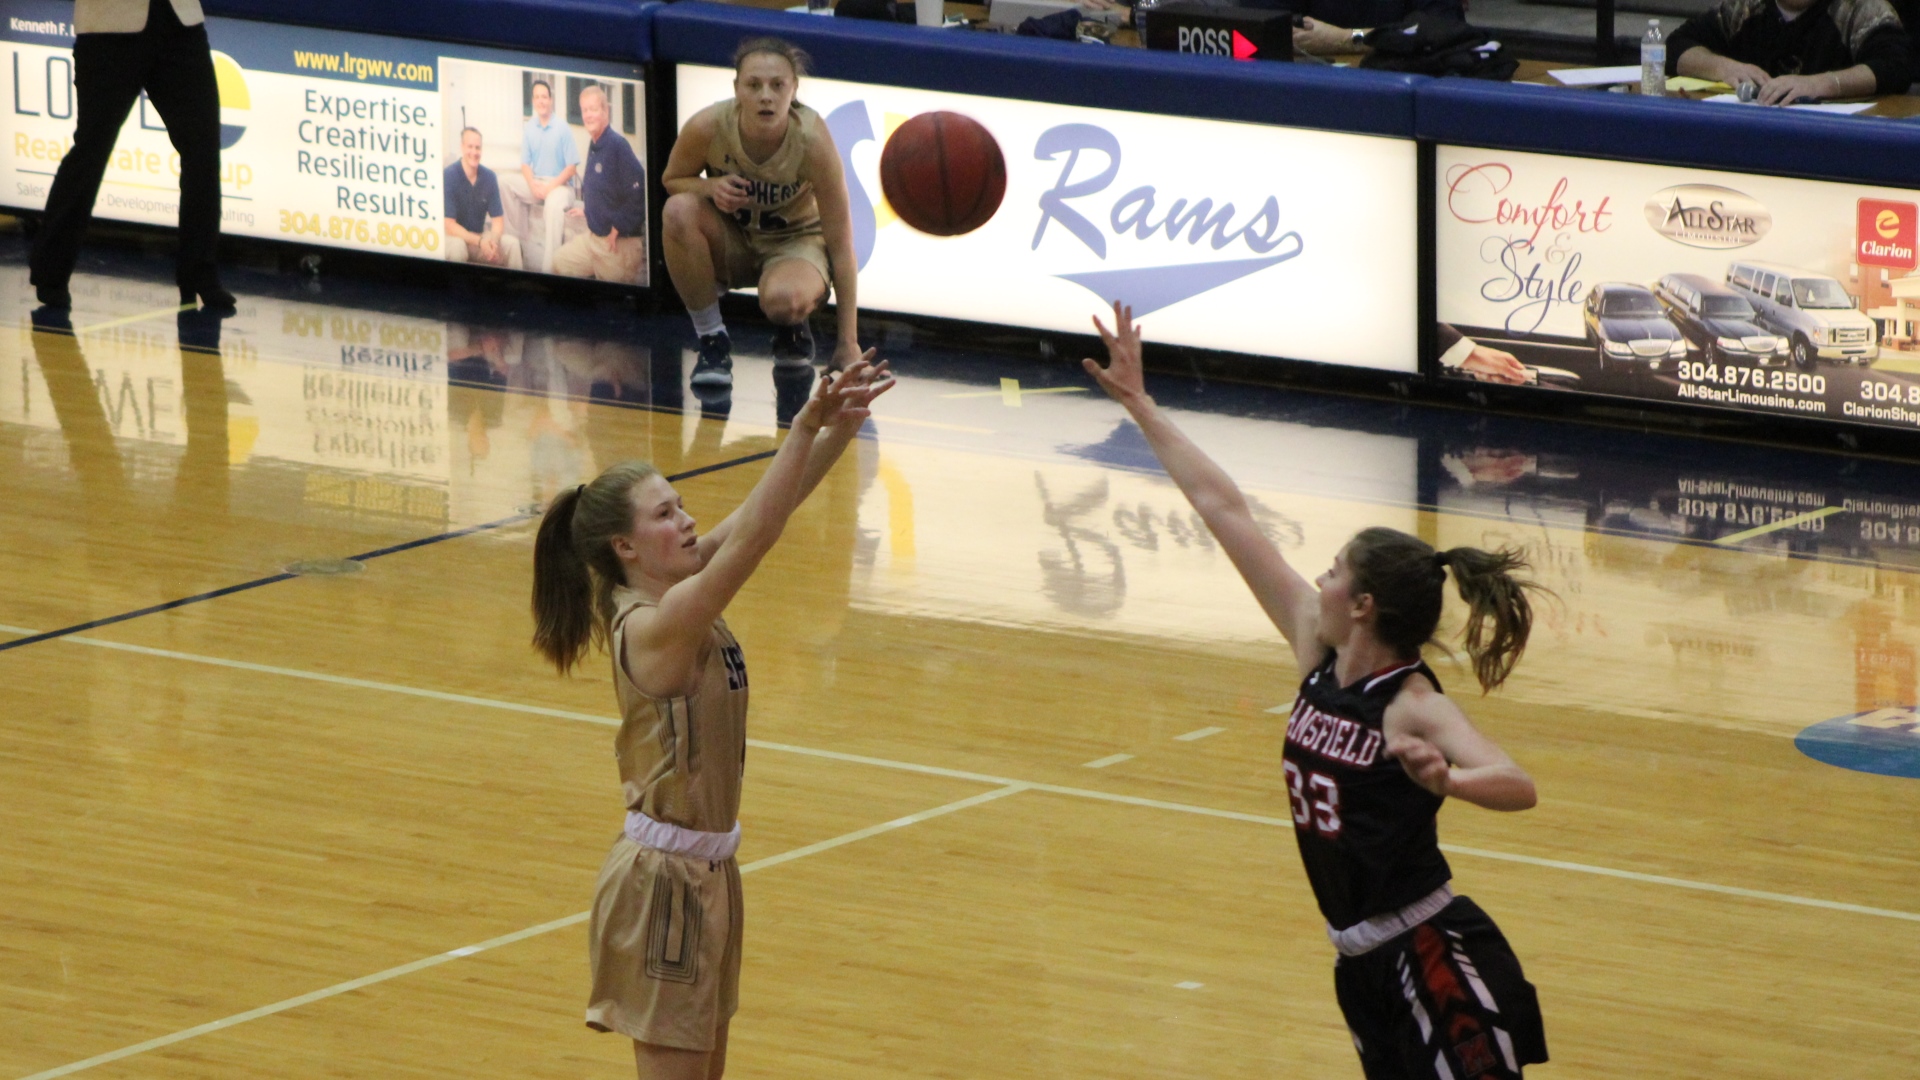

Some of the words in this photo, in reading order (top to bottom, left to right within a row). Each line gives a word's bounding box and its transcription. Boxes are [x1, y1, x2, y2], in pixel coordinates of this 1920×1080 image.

[10, 17, 57, 35] Kenneth
[59, 22, 69, 37] F.
[1178, 26, 1230, 57] POSS
[294, 50, 433, 83] www.lrgwv.com
[305, 89, 435, 128] Expertise.
[298, 119, 435, 163] Creativity.
[298, 150, 436, 190] Resilience.
[17, 182, 46, 199] Sales
[107, 193, 180, 216] Developmen
[337, 186, 436, 221] Results.
[1033, 123, 1303, 260] Rams
[1446, 162, 1612, 249] Comfort
[279, 209, 440, 252] 304.876.8000
[1675, 230, 1741, 244] LIMOUSINE
[1861, 240, 1912, 259] Clarion
[1480, 235, 1587, 337] Style
[1678, 361, 1826, 394] 304.876.2500
[1678, 383, 1826, 412] All-StarLimousine.com
[1287, 699, 1382, 767] ANSFIELD
[1283, 759, 1342, 833] 33
